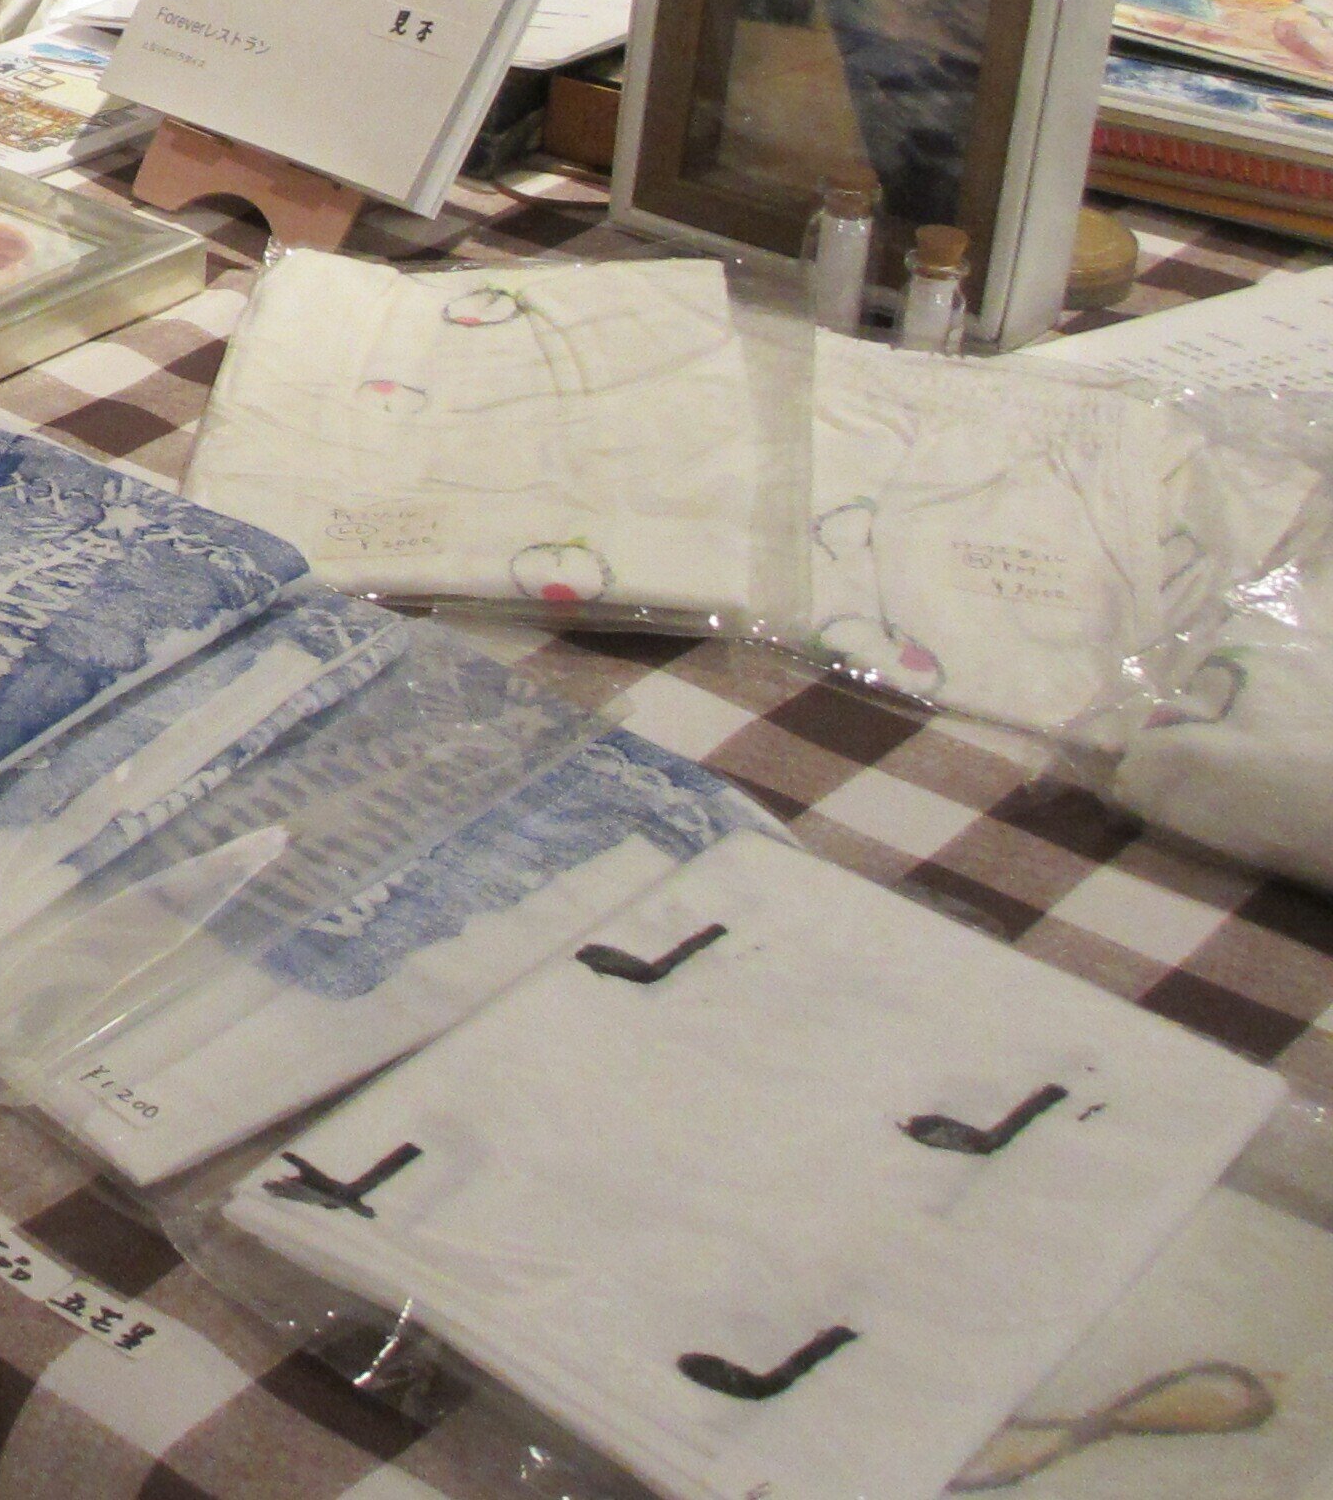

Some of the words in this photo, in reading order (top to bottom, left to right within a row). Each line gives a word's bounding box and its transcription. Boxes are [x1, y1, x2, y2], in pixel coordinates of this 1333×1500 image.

[155, 6, 271, 55] Foreverレストラン
